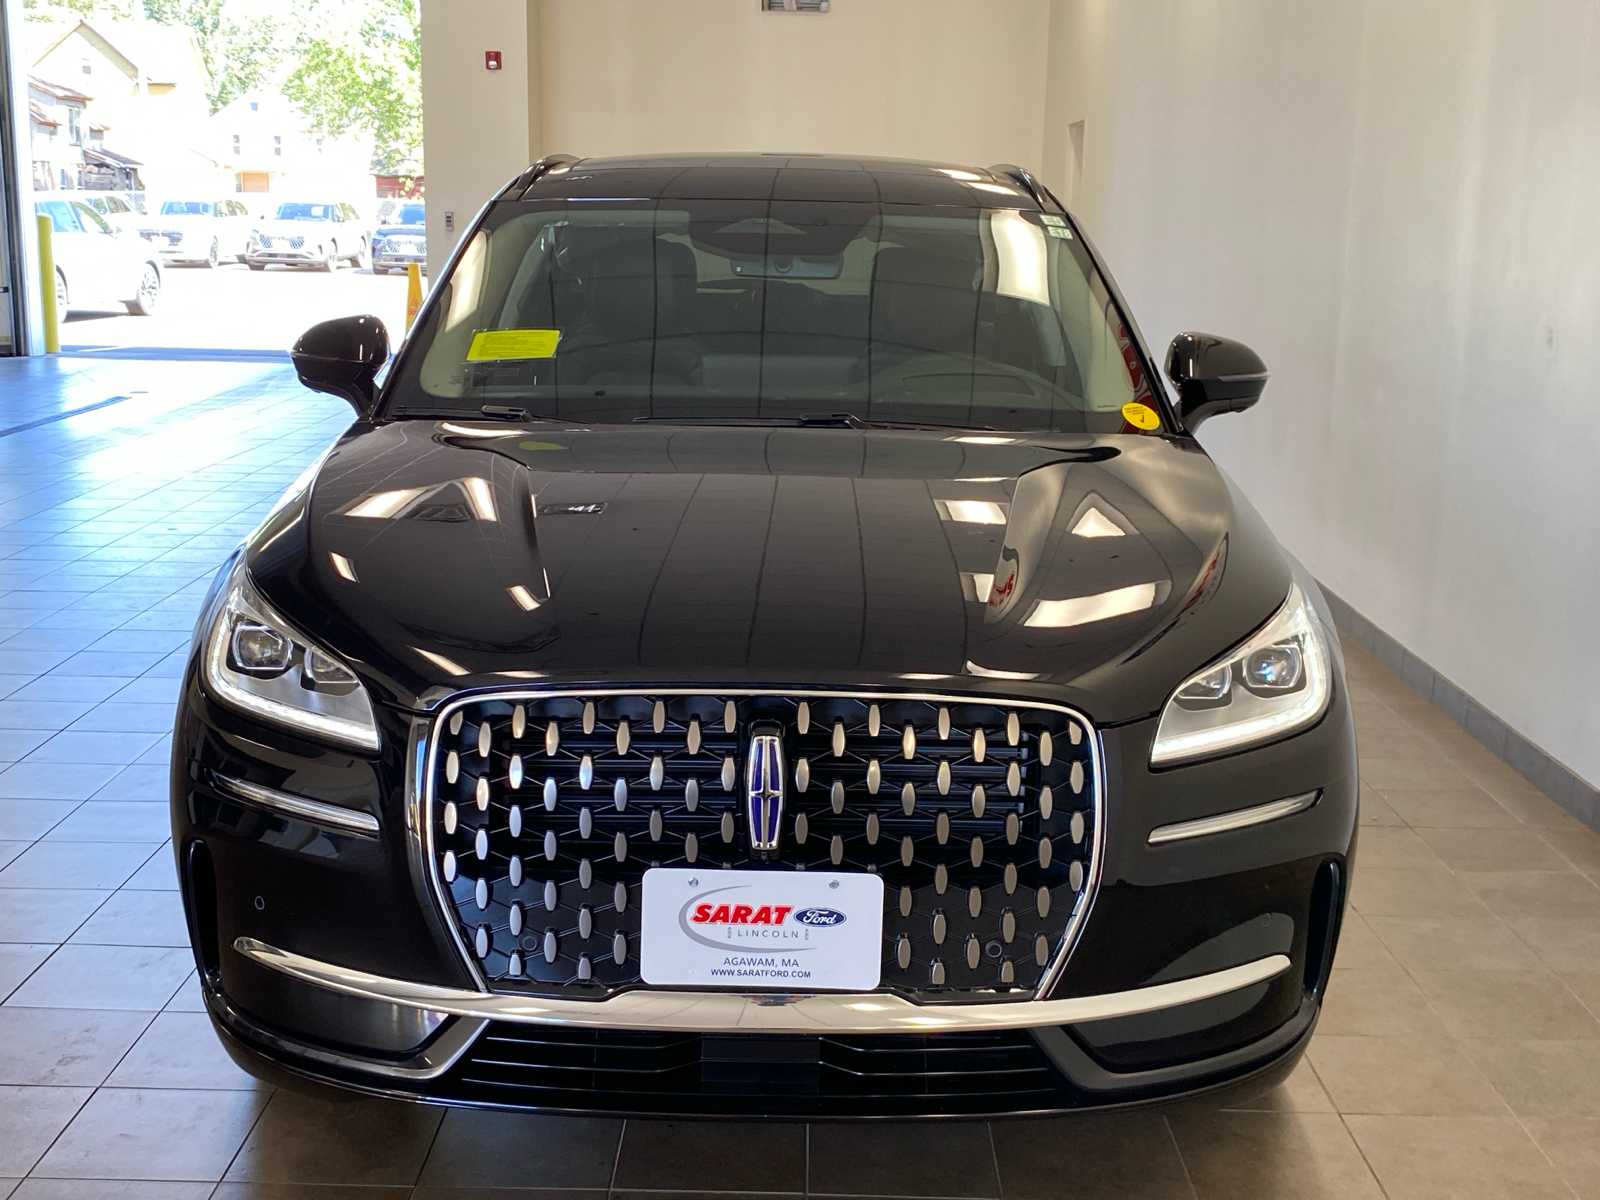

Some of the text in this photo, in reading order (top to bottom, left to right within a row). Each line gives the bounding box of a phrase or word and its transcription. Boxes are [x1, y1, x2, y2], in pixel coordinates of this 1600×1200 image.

[1049, 227, 1071, 238] E18
[690, 903, 838, 926] SARAT Ford
[737, 929, 799, 939] LINCOLN
[723, 957, 800, 968] AGAWAM, MA
[710, 968, 812, 979] WWW.SARATFORD.COM
